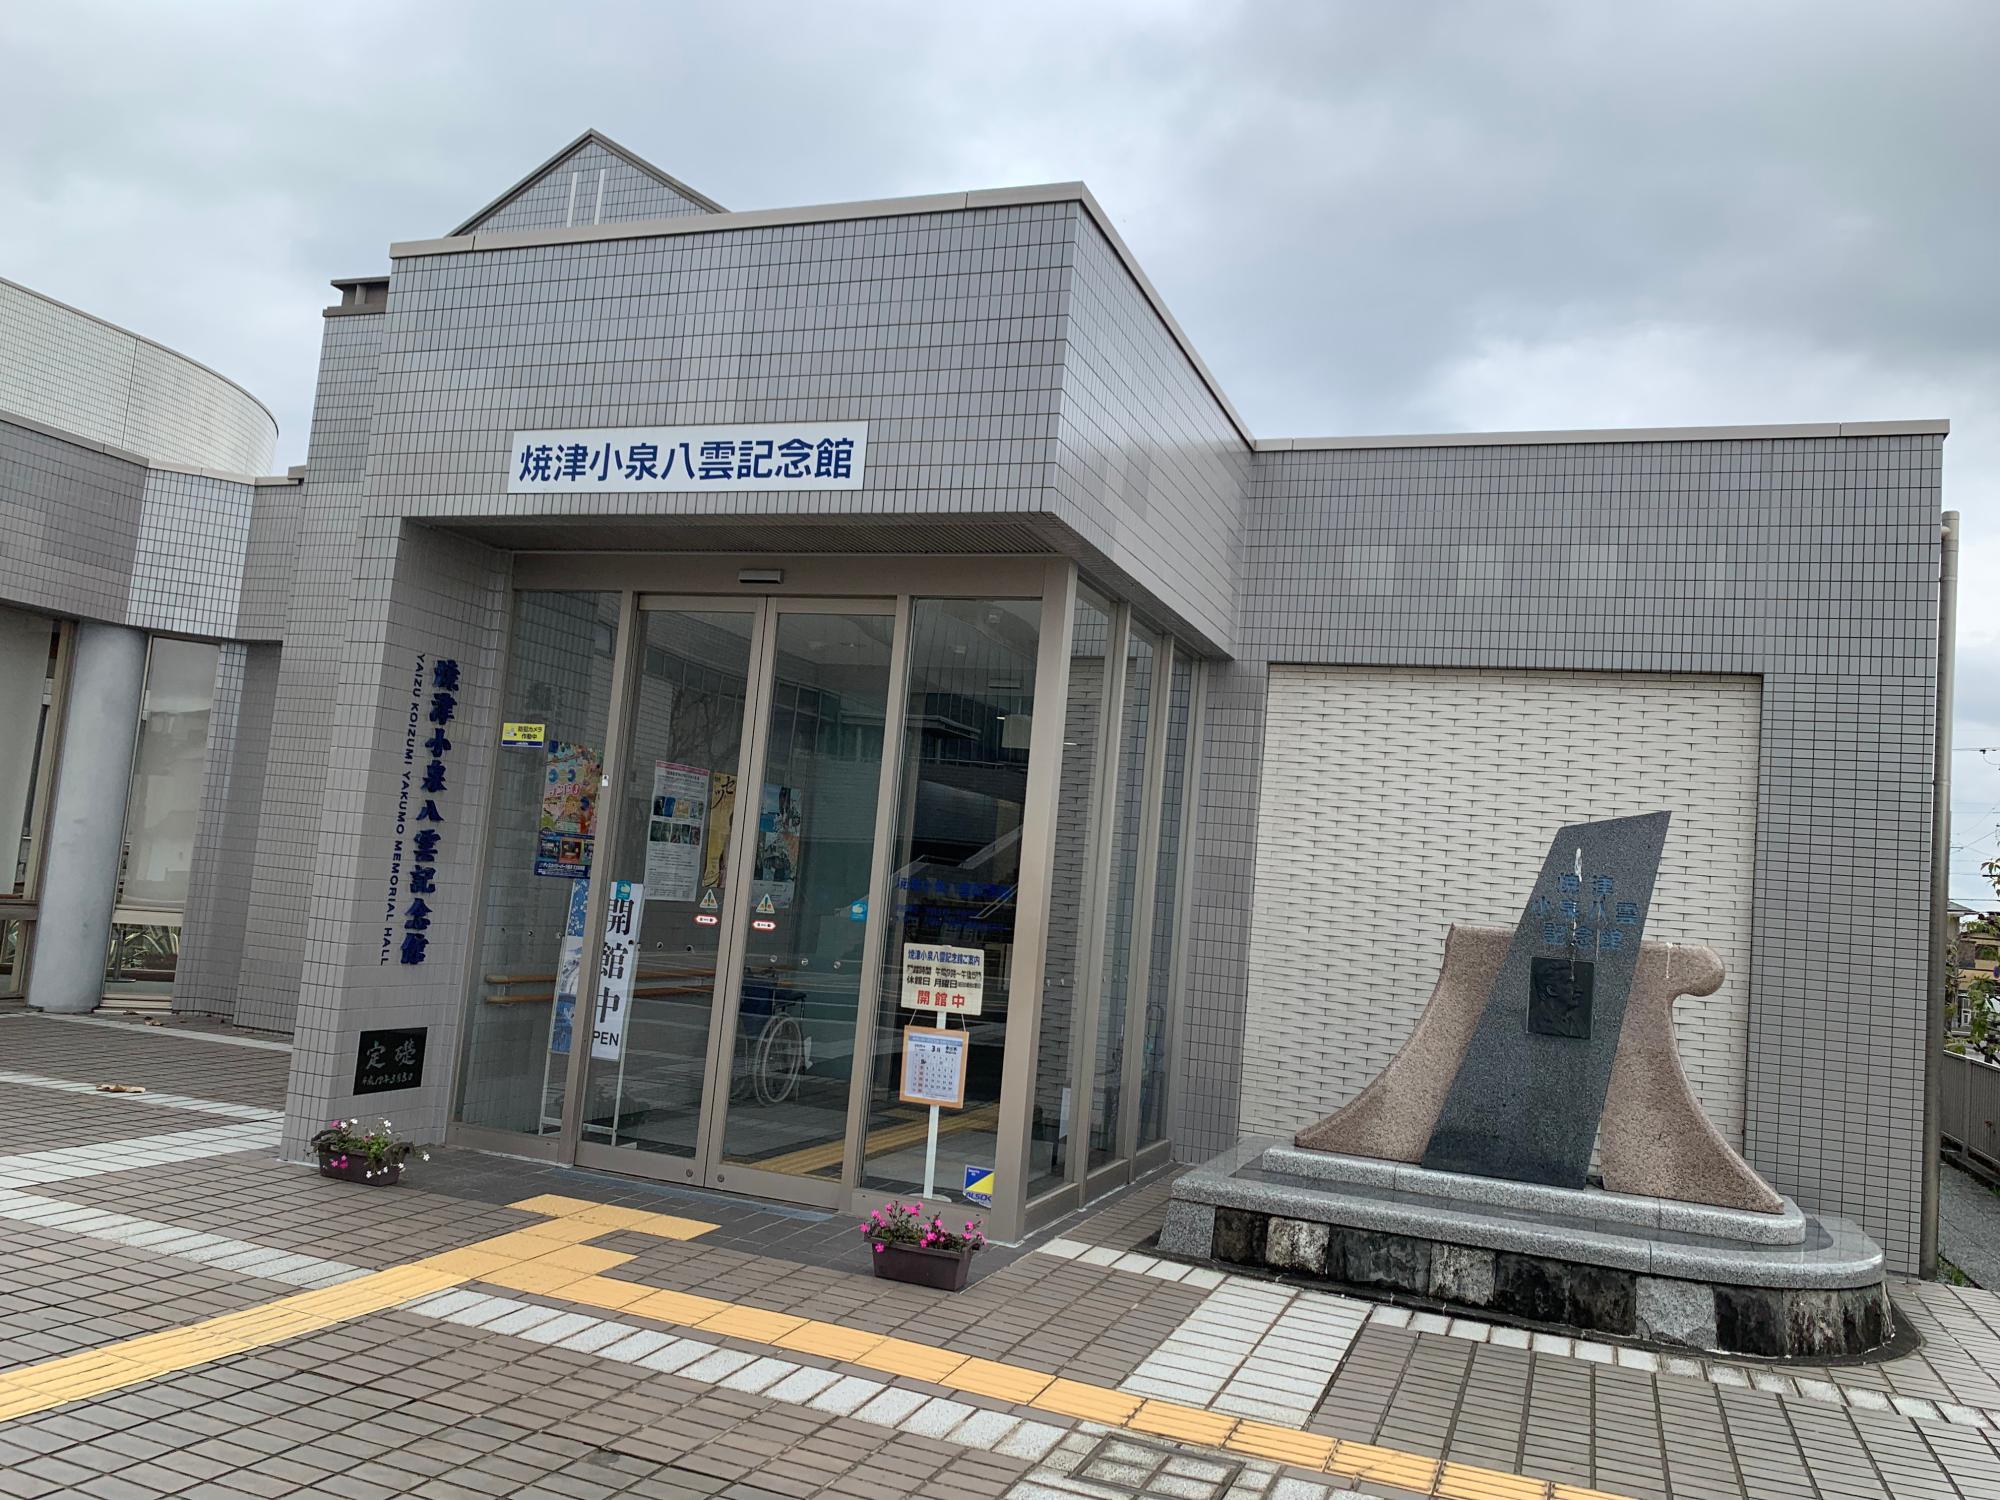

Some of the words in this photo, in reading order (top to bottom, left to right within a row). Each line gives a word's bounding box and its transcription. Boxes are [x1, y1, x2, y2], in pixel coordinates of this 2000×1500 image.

[519, 438, 855, 482] 焼津小泉八雲記念館
[412, 653, 426, 698] YAIZU
[404, 702, 420, 765] KOIZUMI
[396, 771, 412, 835] YAKUMO
[385, 840, 403, 922] MEMORIAL
[1530, 896, 1640, 926] 小泉八雲
[380, 927, 393, 967] HALL
[1544, 922, 1624, 951] 記念館
[906, 976, 931, 986] 休館日
[917, 990, 965, 1009] 開館中
[366, 1038, 416, 1070] 定礎
[593, 1031, 619, 1046] PEN
